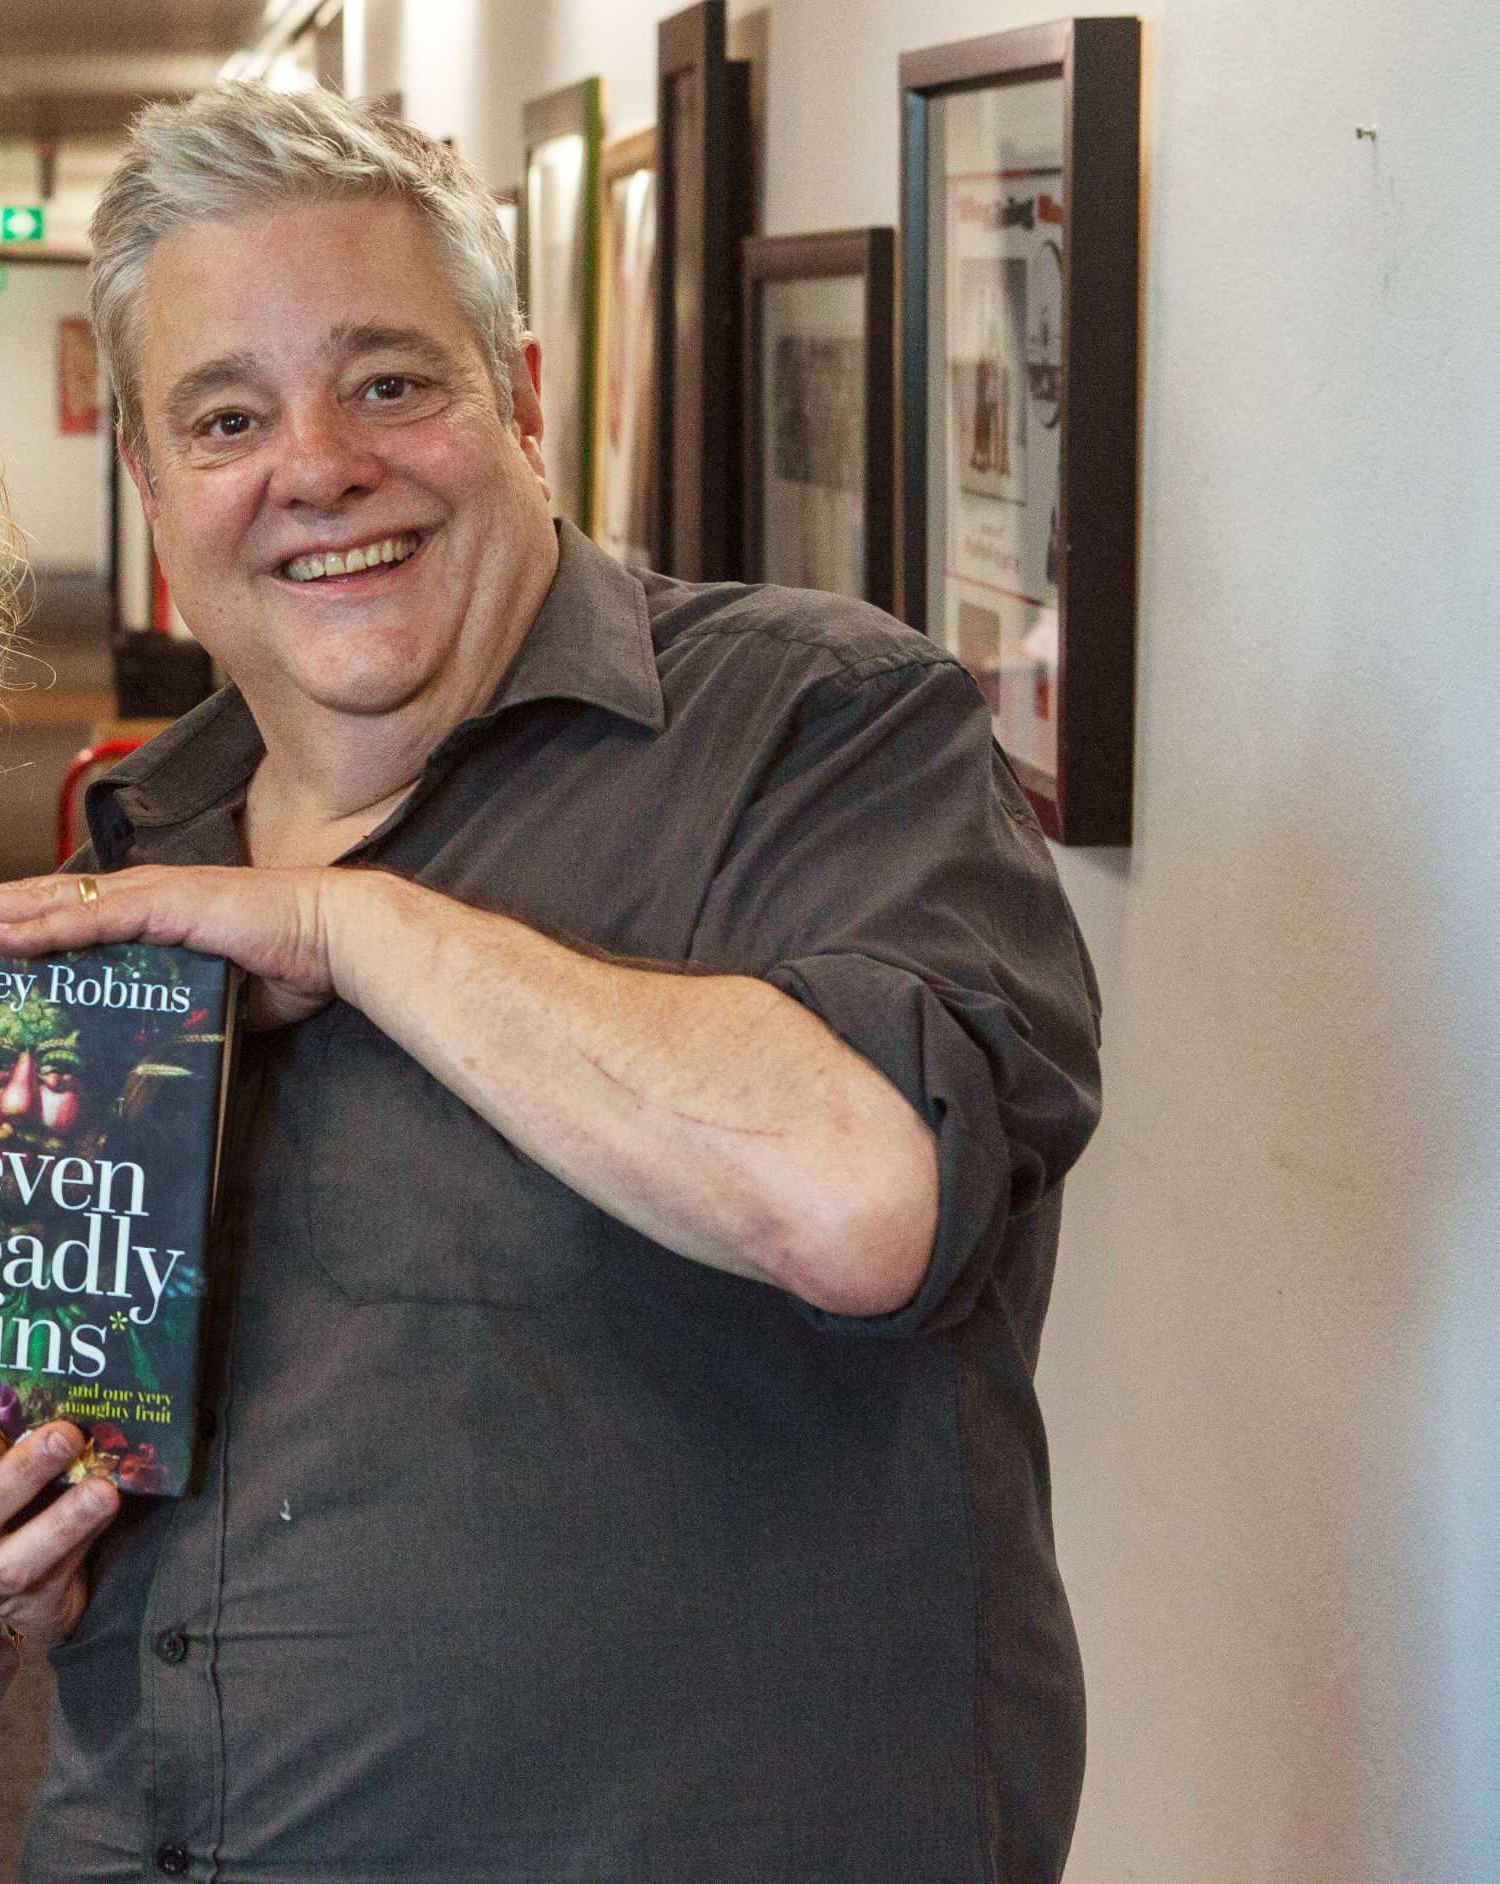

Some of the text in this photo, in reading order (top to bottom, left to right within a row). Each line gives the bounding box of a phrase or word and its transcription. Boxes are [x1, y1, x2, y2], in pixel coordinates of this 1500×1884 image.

[46, 964, 192, 1013] Robins
[67, 1382, 174, 1407] and one very
[135, 1404, 173, 1424] fruit
